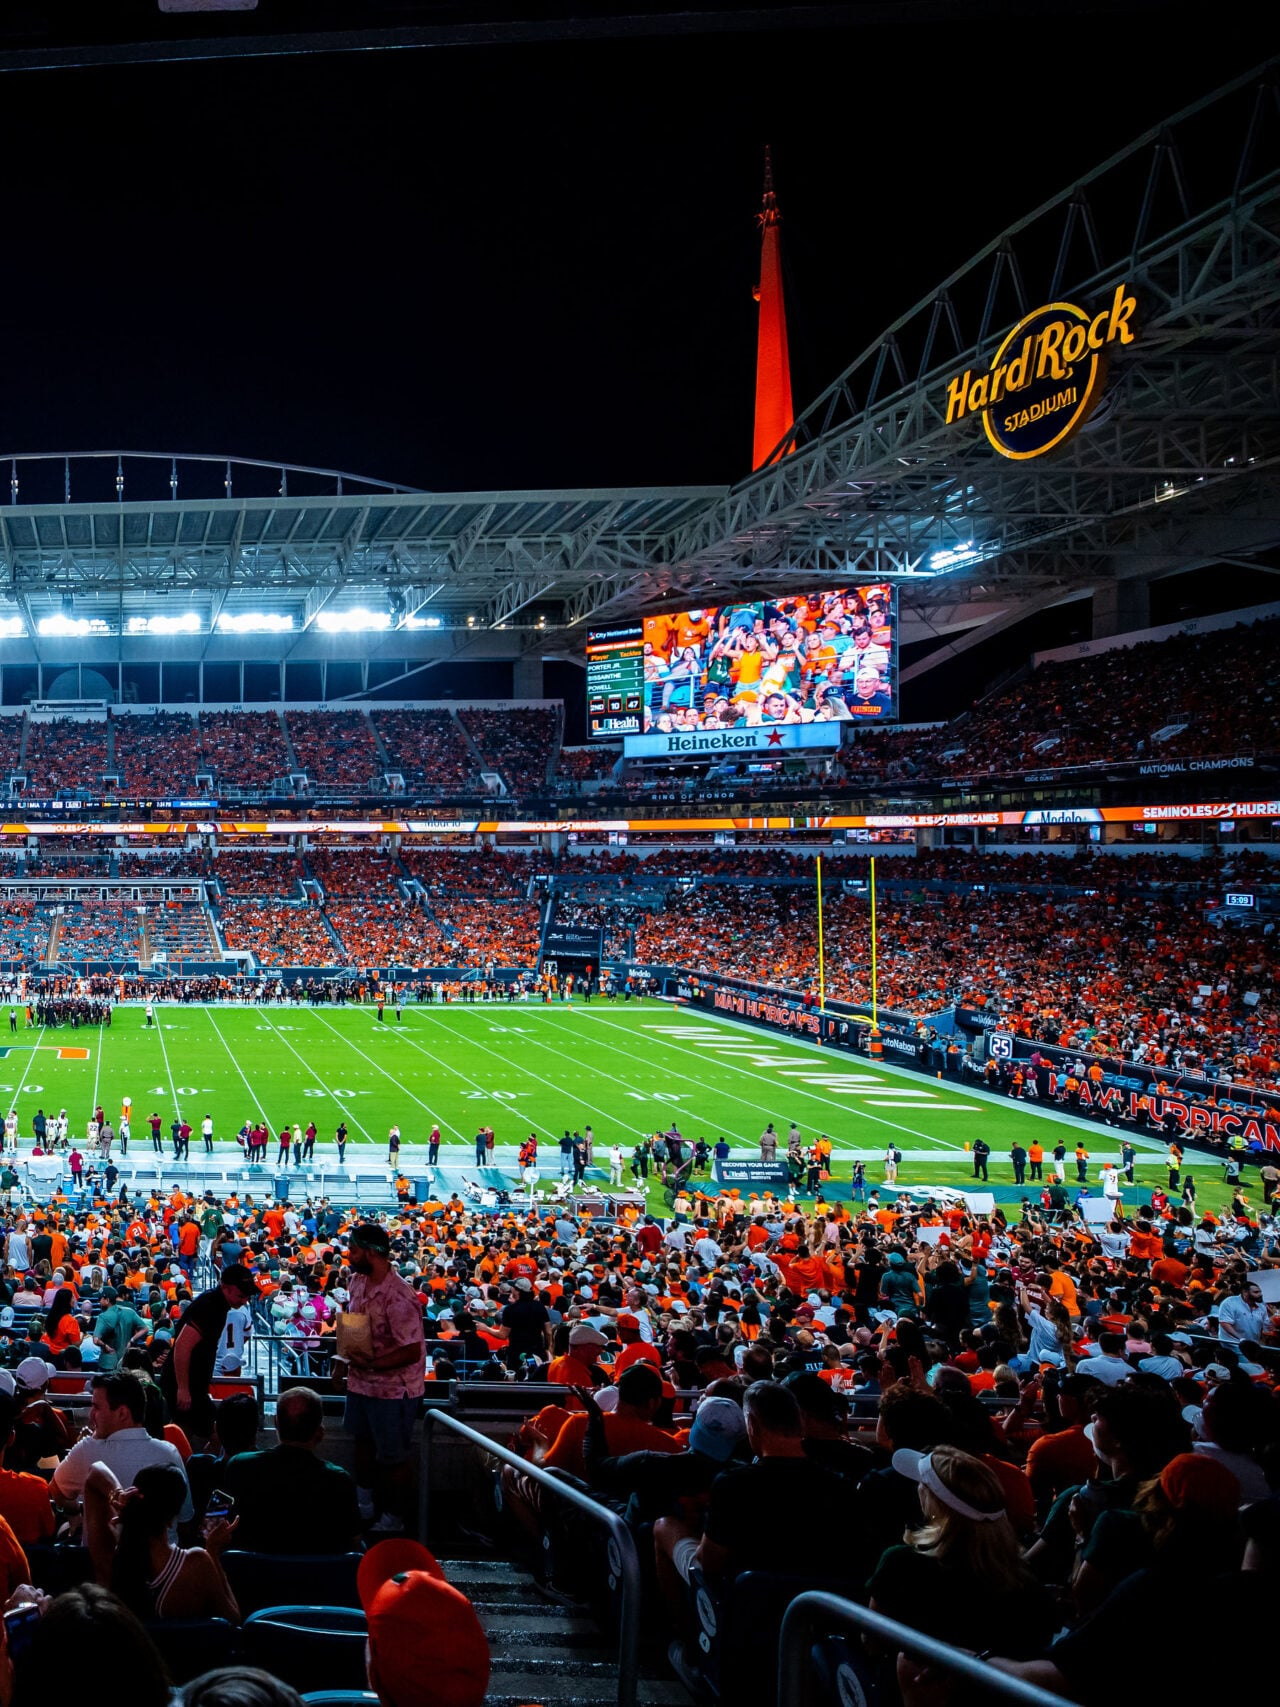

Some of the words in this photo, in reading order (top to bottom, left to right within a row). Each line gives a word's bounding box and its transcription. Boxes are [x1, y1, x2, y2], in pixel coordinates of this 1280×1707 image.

[945, 336, 1032, 425] Hard
[1037, 284, 1137, 380] Rock
[1004, 387, 1077, 432] STADIUM
[588, 663, 611, 671] PORTER
[588, 684, 611, 692] POWELL
[628, 700, 638, 708] 47
[667, 733, 758, 752] Heineken
[1140, 763, 1187, 775] NATIONAL
[1189, 757, 1254, 771] CHAMPIONS
[1143, 805, 1213, 818] SEMINOLES
[947, 813, 1000, 825] HURRICANES
[1231, 896, 1249, 904] 5:09
[628, 967, 651, 979] Modelo
[992, 1038, 1009, 1057] 25
[147, 1086, 198, 1095] 40
[303, 1089, 356, 1098] 30
[460, 1090, 517, 1099] 20
[624, 1091, 681, 1102] 10
[132, 1227, 143, 1236] 21
[226, 1323, 235, 1349] 1
